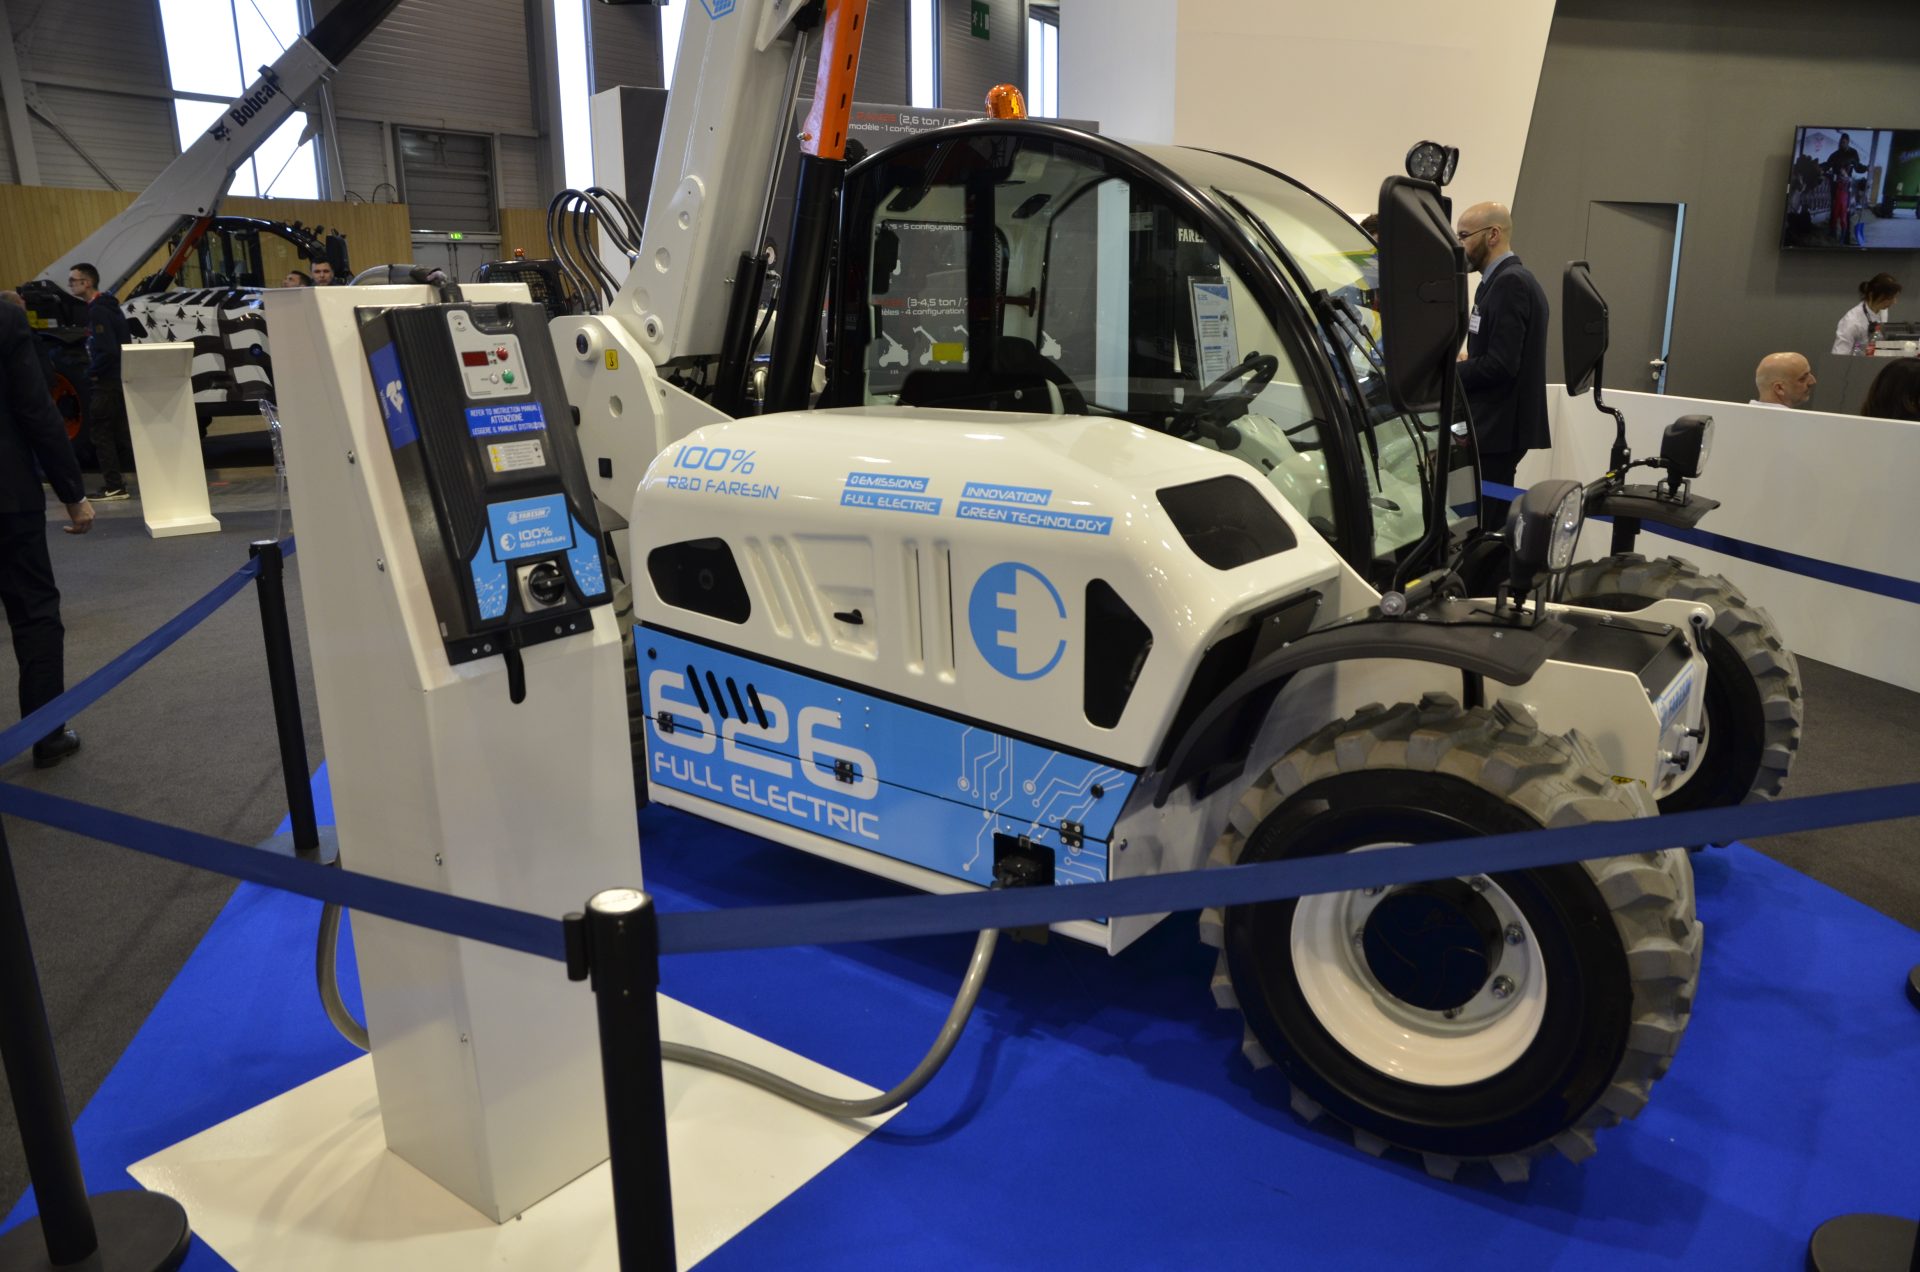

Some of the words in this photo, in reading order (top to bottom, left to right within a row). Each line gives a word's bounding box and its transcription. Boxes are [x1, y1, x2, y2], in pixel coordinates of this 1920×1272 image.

[922, 116, 940, 126] ton
[1178, 228, 1207, 243] FARE
[938, 298, 956, 306] ton
[912, 308, 965, 316] configuration
[490, 413, 524, 424] ATTENZIONE
[673, 445, 756, 474] 100%
[667, 475, 701, 491] R&D
[705, 479, 780, 499] FARESIN
[966, 487, 1047, 504] INNOVATION
[845, 493, 874, 506] FULL
[877, 499, 937, 512] ELECTRIC
[960, 505, 1008, 520] GREEN
[1011, 511, 1107, 531] TECHNOLOGY
[519, 526, 553, 541] 100%
[648, 669, 879, 801] 626
[654, 752, 723, 792] FULL
[731, 774, 880, 840] ELECTRIC
